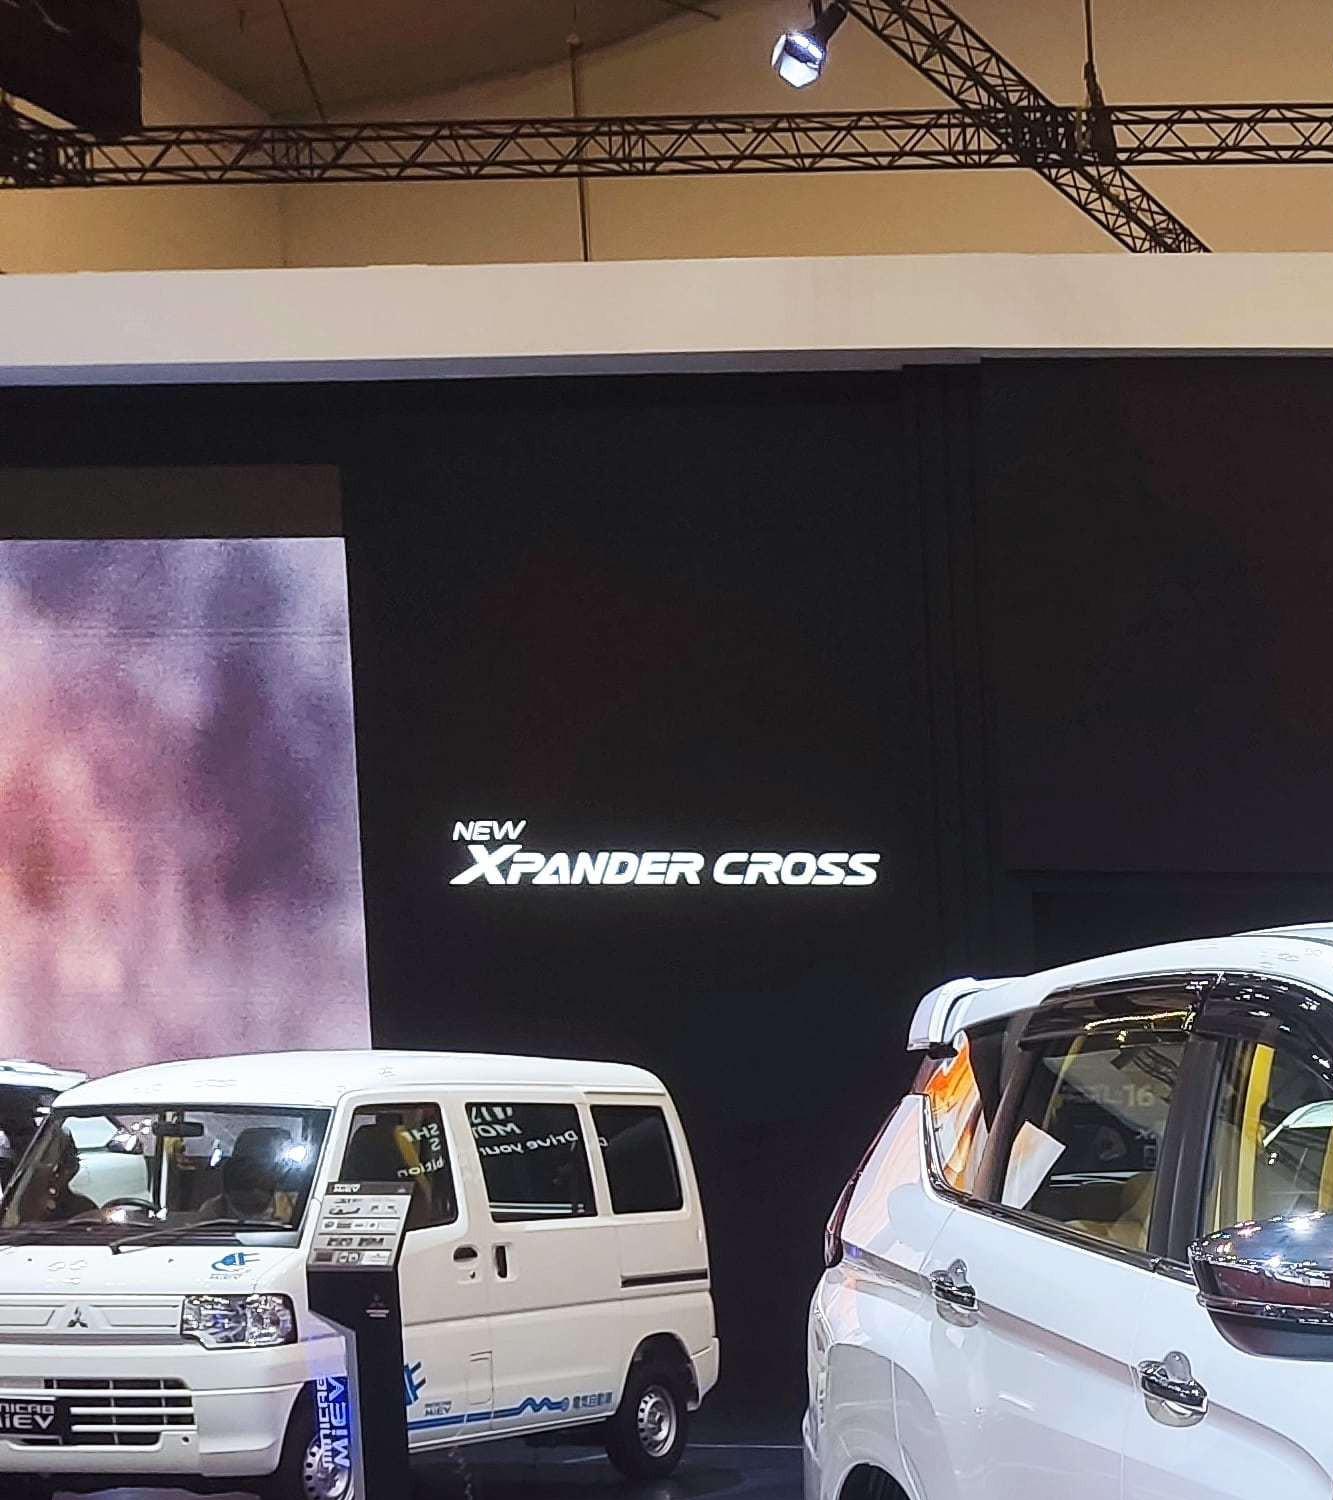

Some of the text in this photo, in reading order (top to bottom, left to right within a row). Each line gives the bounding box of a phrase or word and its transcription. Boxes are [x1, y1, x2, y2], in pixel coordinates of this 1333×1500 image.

[452, 820, 527, 841] NEW
[449, 844, 881, 886] XPANDER CROSS
